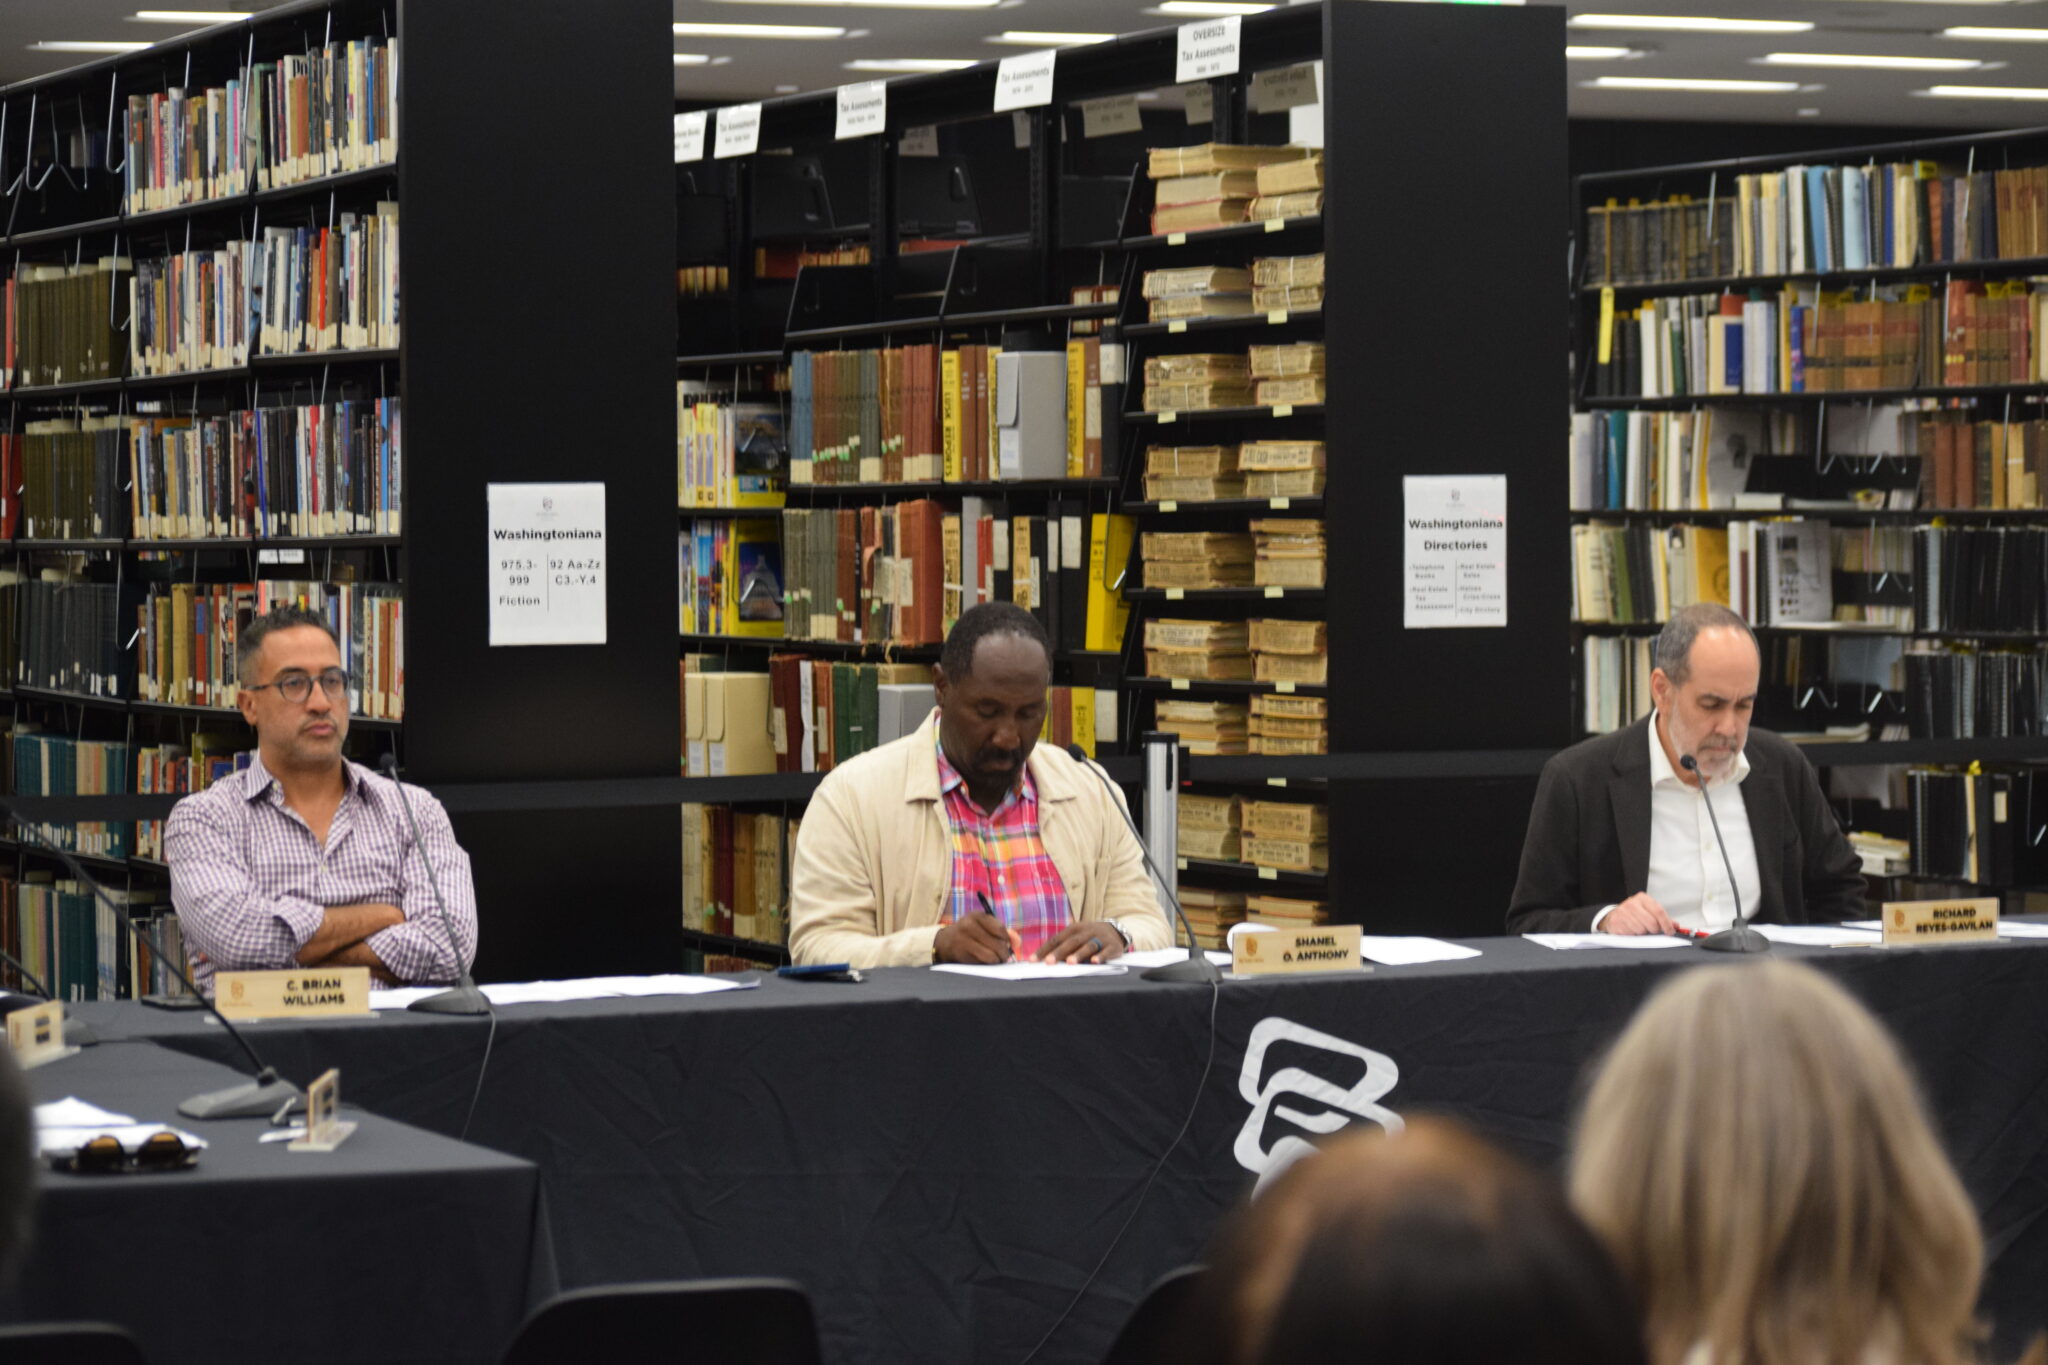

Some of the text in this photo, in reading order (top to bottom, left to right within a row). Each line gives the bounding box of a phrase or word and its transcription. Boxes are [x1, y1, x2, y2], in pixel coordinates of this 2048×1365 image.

[1193, 24, 1226, 42] OVERSIZE
[1182, 43, 1235, 62] Tax Assessments
[1409, 519, 1503, 531] Washingtoniana
[494, 528, 602, 542] Washingtoniana
[1424, 540, 1488, 551] Directories
[550, 559, 563, 570] 92
[509, 575, 530, 585] 999
[499, 595, 541, 607] Fiction
[1933, 908, 1977, 920] RICHARD
[1295, 936, 1337, 948] SHANEL
[1296, 949, 1349, 962] ANTHONY
[286, 978, 341, 991] C. BRIAN
[283, 993, 345, 1007] WILLIAMS
